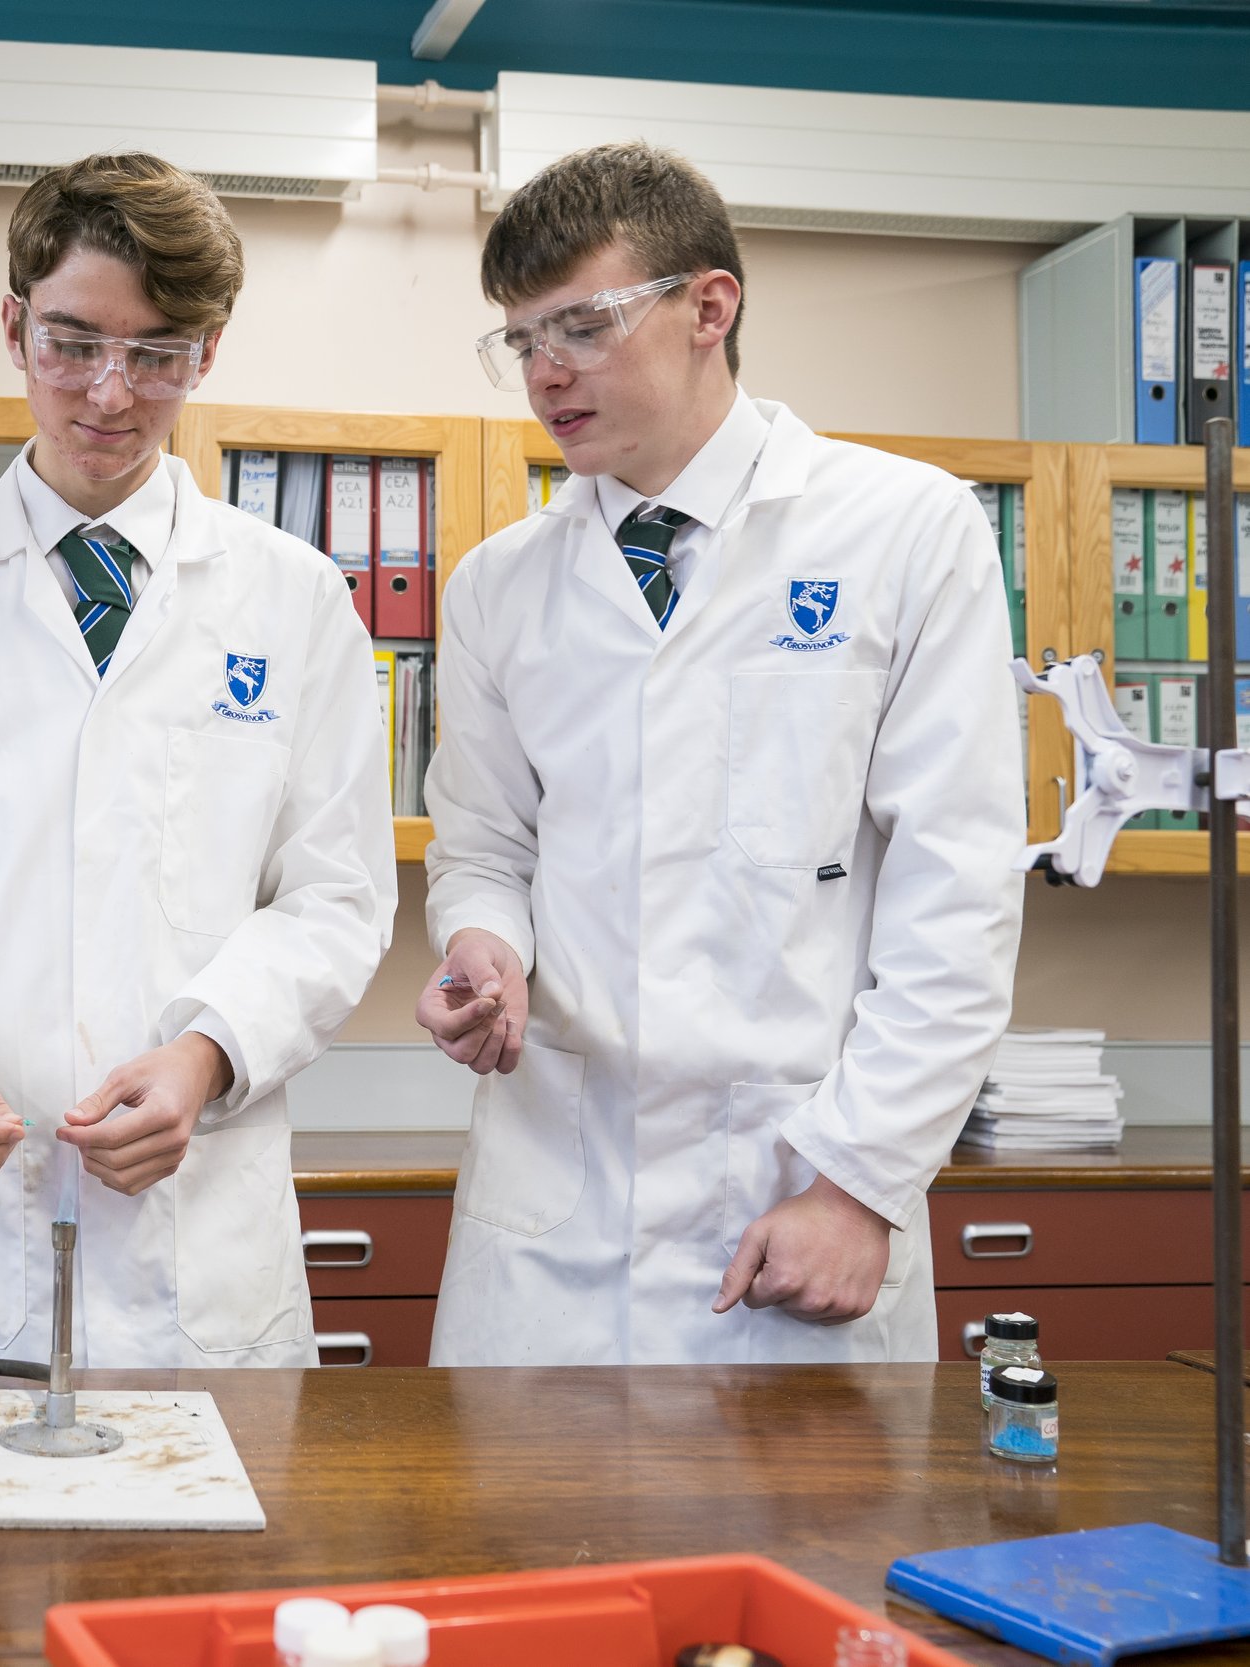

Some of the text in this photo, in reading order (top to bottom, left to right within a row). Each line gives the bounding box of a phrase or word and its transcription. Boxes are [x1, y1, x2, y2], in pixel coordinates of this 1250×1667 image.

[333, 461, 369, 473] elite
[336, 482, 361, 494] CEA
[385, 476, 410, 489] CEA
[338, 496, 363, 510] A21
[386, 494, 414, 509] A22
[787, 640, 835, 650] GROSVENOR
[222, 709, 265, 722] GROSVENOR
